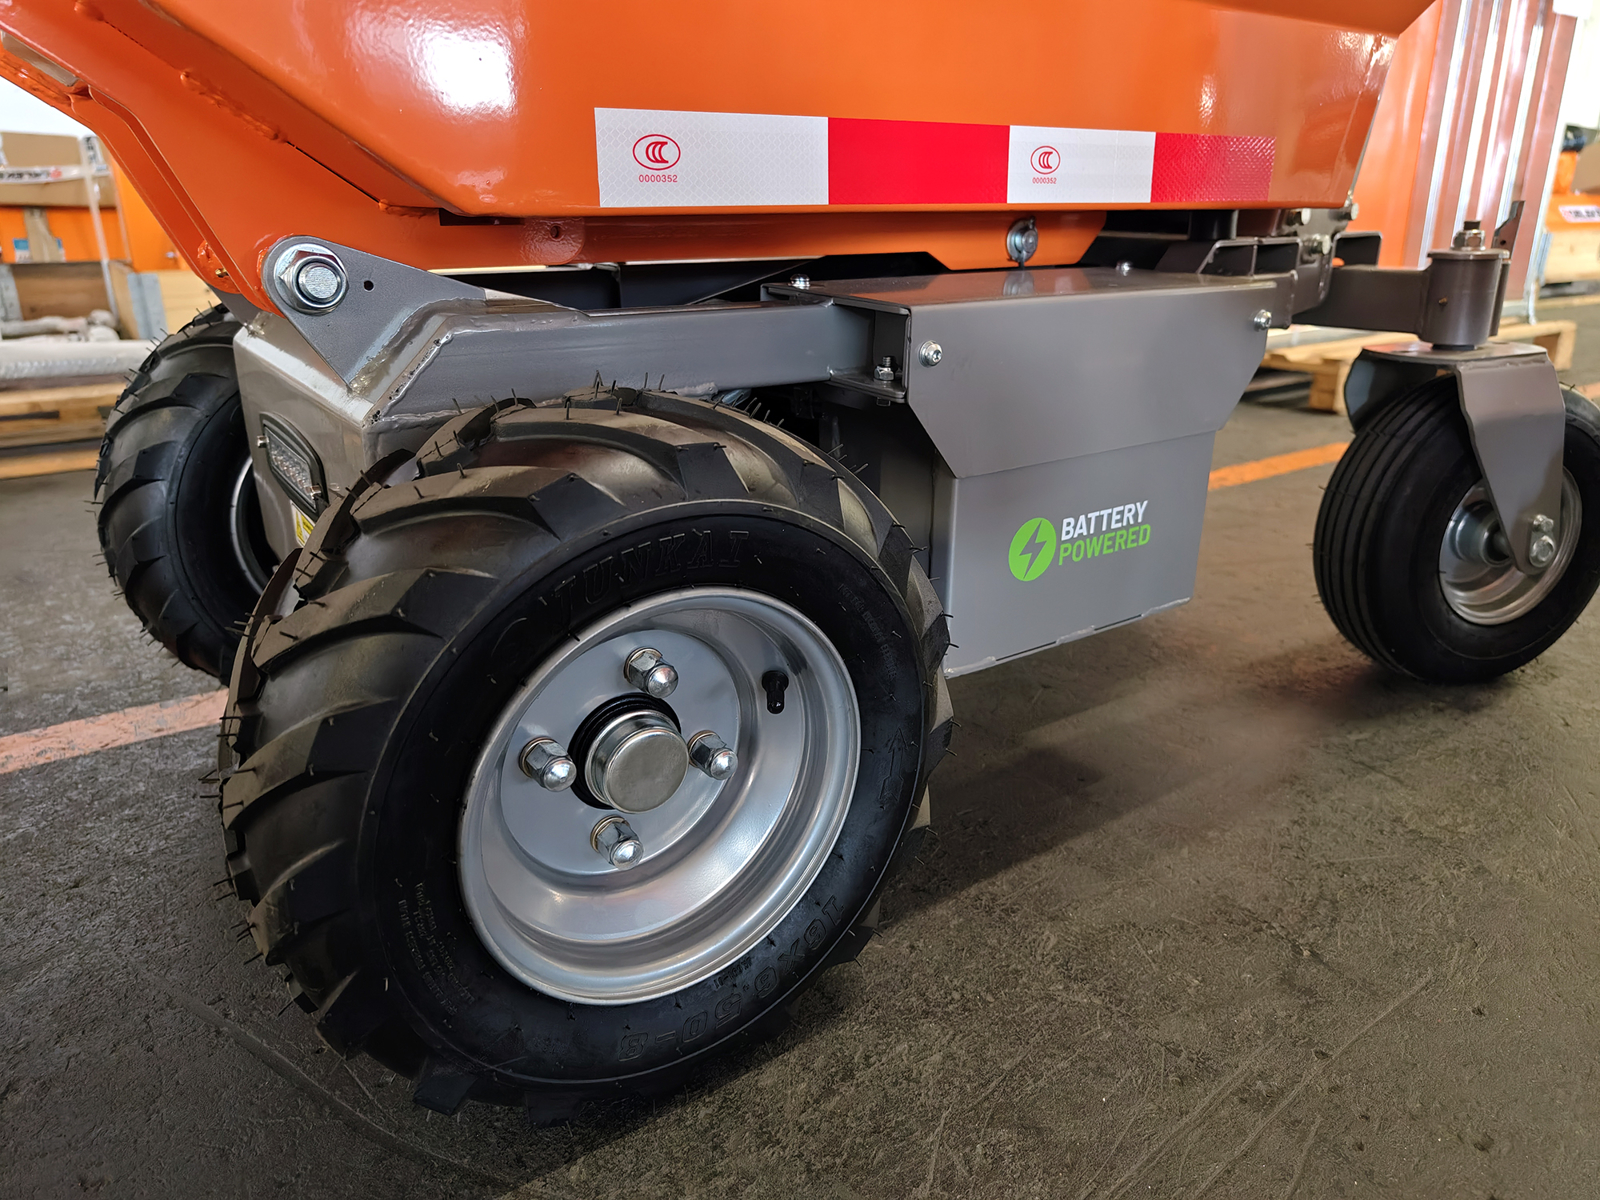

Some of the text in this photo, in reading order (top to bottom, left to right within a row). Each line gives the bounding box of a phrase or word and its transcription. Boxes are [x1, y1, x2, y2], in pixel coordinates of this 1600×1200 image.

[638, 174, 678, 183] 0000352
[1032, 177, 1058, 185] 0000352
[1061, 500, 1149, 541] BATTERY
[1058, 524, 1151, 566] POWERED
[618, 895, 847, 1062] 16X6.50-8
